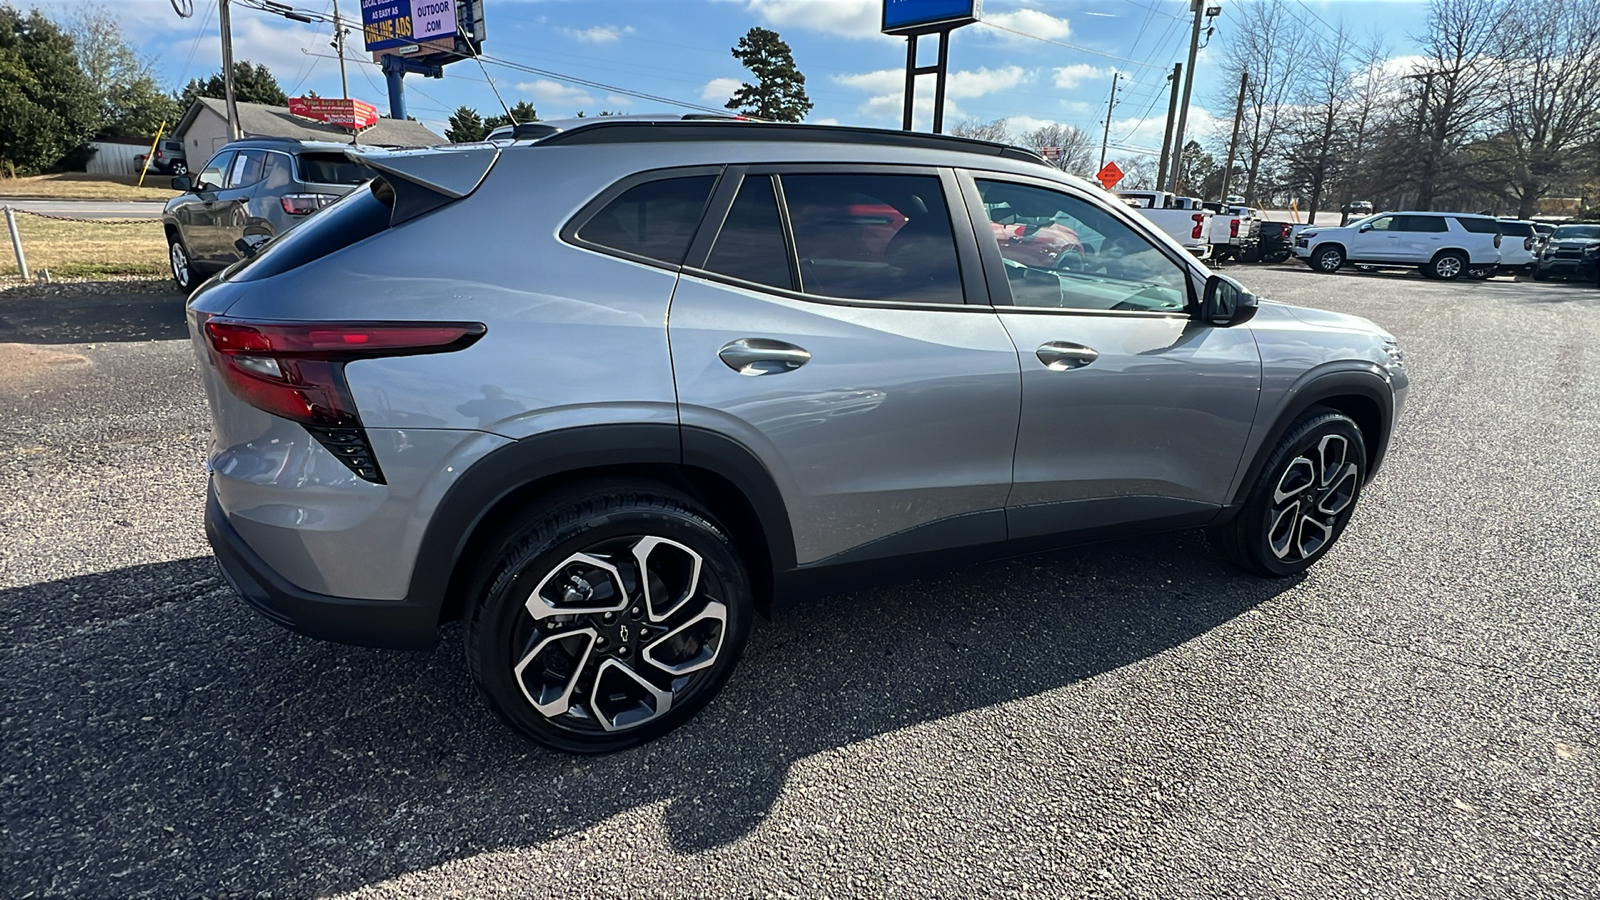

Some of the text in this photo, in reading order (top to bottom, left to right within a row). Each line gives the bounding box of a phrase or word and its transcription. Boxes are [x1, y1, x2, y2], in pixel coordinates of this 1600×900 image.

[372, 6, 399, 20] AS EASY AS
[417, 1, 450, 18] OUTDOOR
[365, 15, 412, 44] ONLINE ADS
[425, 19, 442, 33] .COM
